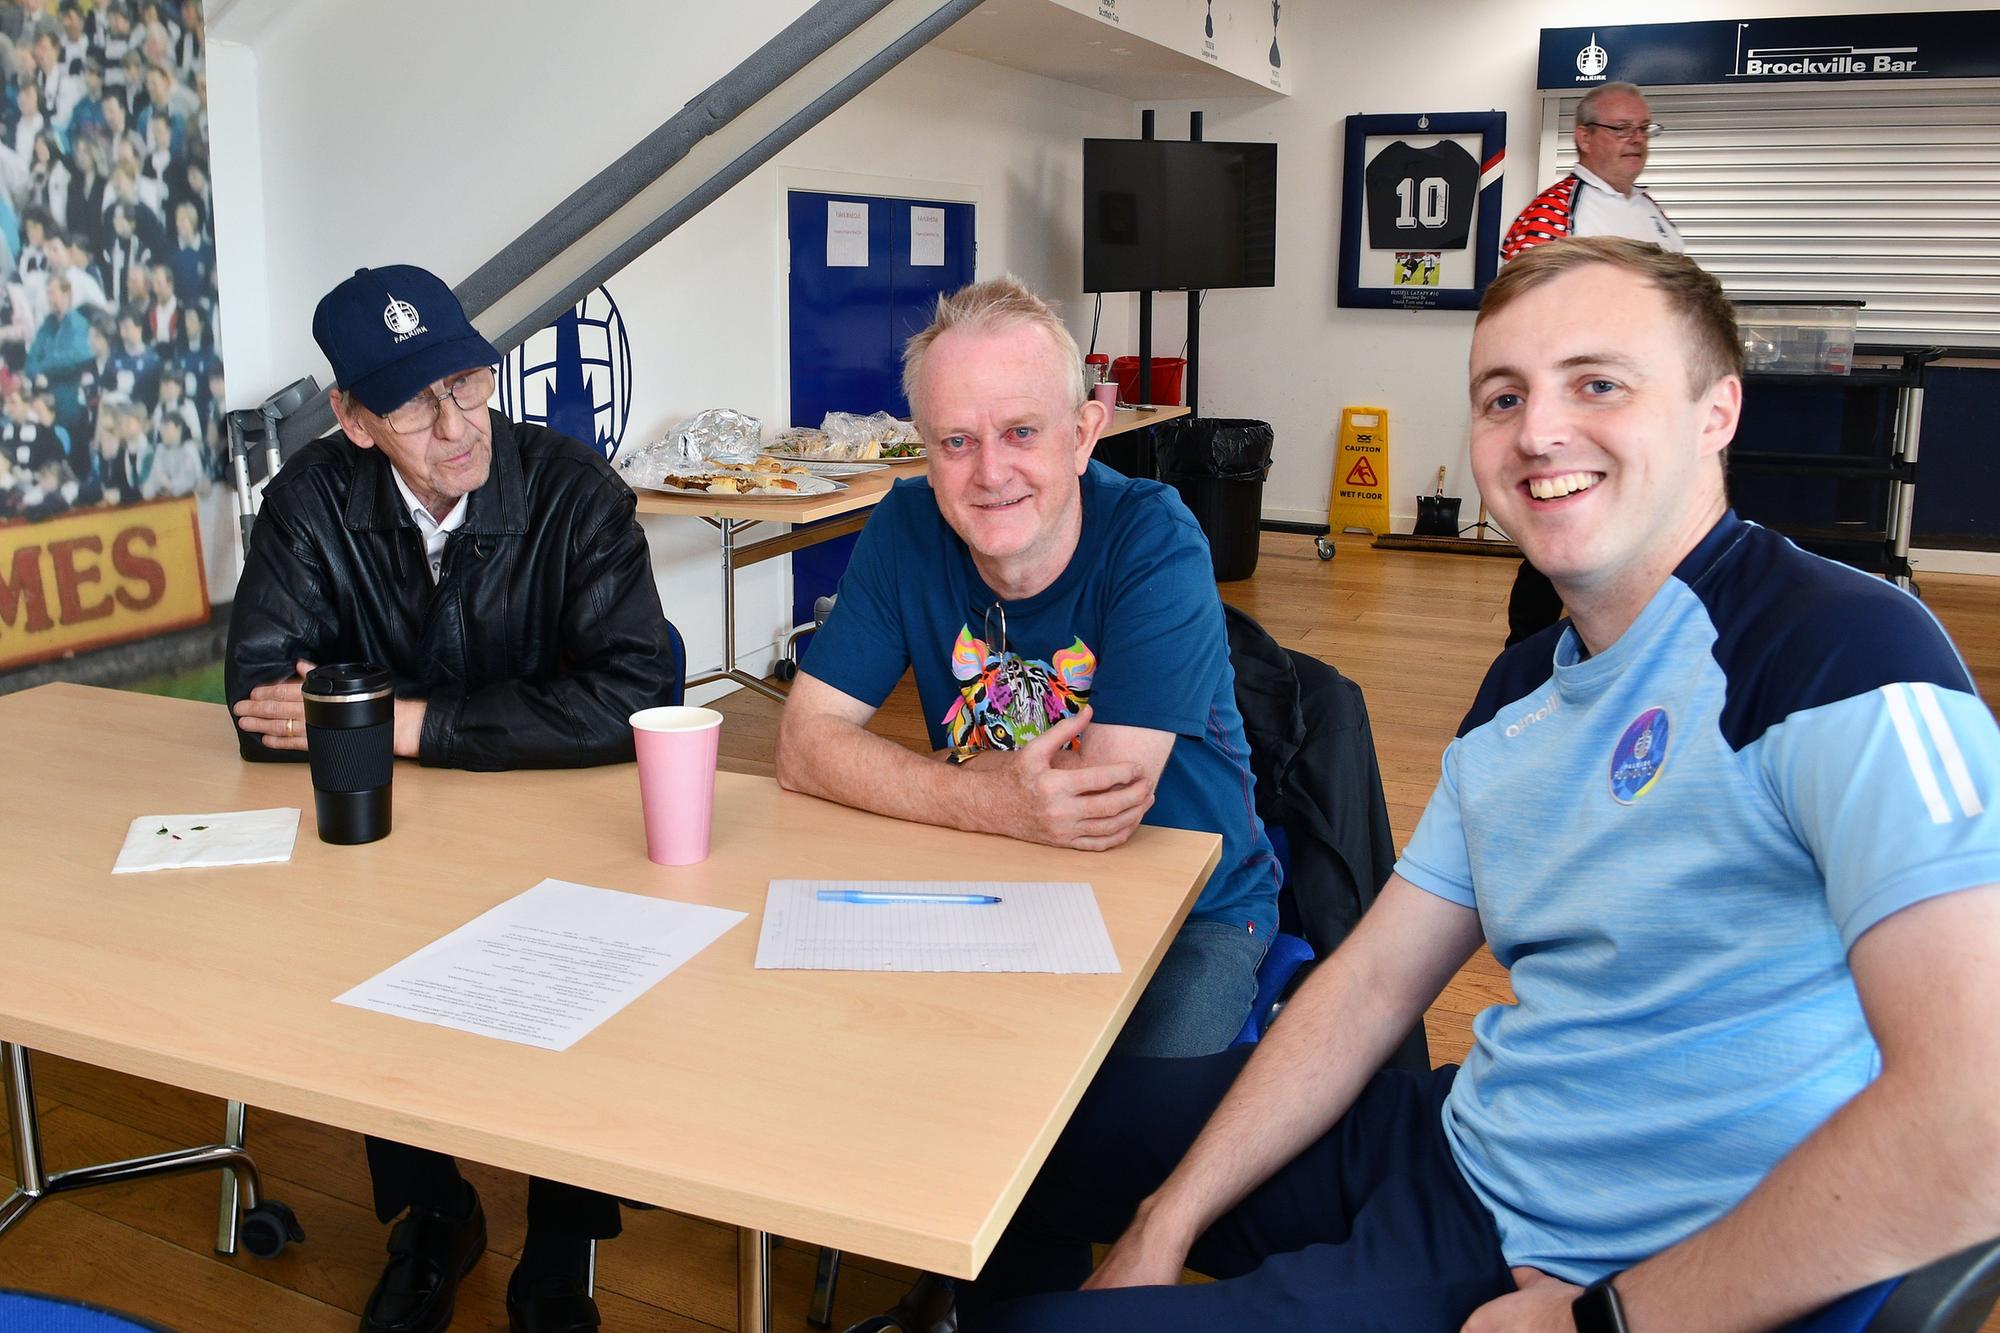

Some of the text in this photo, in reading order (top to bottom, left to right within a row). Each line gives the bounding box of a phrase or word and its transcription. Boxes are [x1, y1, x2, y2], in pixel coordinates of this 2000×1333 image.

[1747, 56, 1917, 75] Brockville Bar
[1395, 177, 1449, 229] 10
[393, 325, 428, 344] FALKIRK
[1344, 445, 1381, 453] CAUTION
[1339, 490, 1383, 500] WET FLOOR
